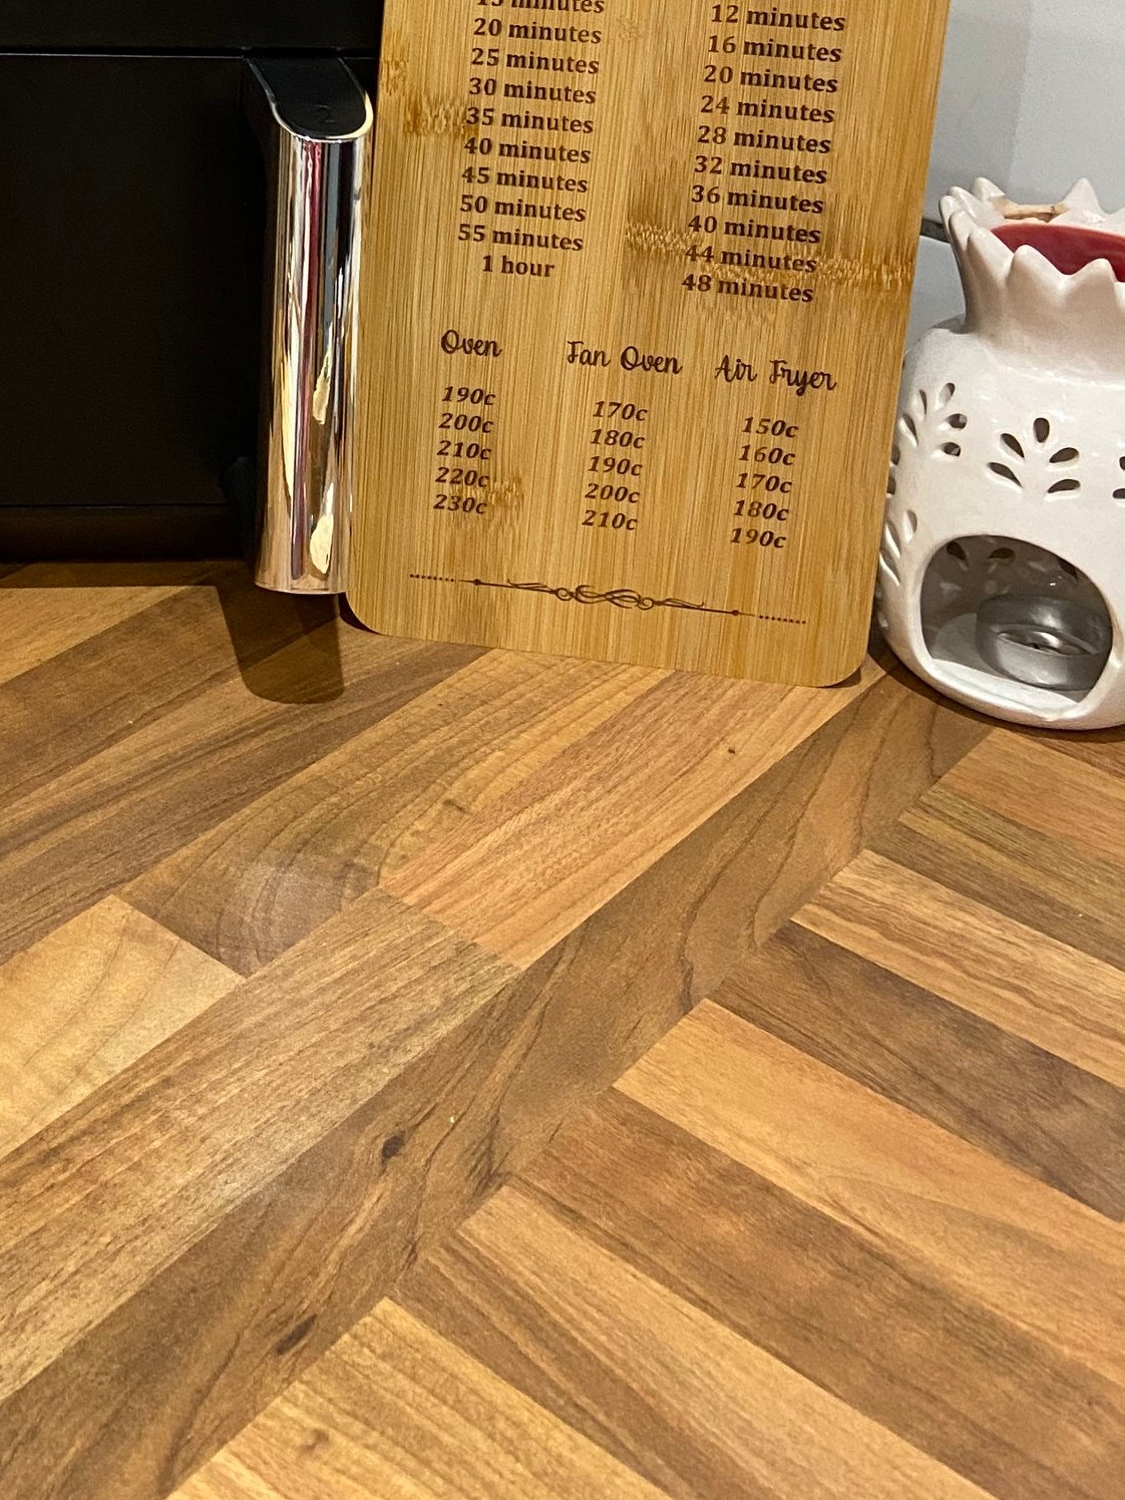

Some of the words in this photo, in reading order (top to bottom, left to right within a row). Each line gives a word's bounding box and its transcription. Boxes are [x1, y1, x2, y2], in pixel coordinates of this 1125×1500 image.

[473, 18, 502, 38] 20
[508, 21, 602, 44] minutes
[710, 4, 739, 24] 12
[745, 7, 846, 32] minutes
[471, 48, 499, 67] 25
[506, 51, 600, 74] minutes
[708, 35, 737, 54] 16
[743, 38, 842, 63] minutes
[469, 78, 497, 97] 30
[503, 81, 597, 104] minutes
[703, 65, 733, 84] 20
[739, 69, 839, 94] minutes
[700, 95, 729, 115] 24
[737, 100, 835, 124] minutes
[464, 137, 492, 156] 40
[498, 140, 591, 164] minutes
[697, 125, 726, 145] 28
[733, 130, 832, 154] minutes
[462, 166, 490, 186] 45
[496, 170, 589, 193] minutes
[695, 155, 723, 175] 32
[730, 160, 828, 185] minutes
[460, 195, 487, 214] 50
[494, 198, 587, 222] minutes
[691, 185, 721, 204] 36
[727, 189, 824, 214] minutes
[458, 224, 486, 243] 55
[492, 228, 584, 251] minutes
[688, 215, 717, 234] 40
[724, 219, 821, 244] minutes
[482, 255, 494, 273] 1
[501, 256, 555, 278] hour
[441, 329, 503, 358] Oven
[567, 340, 611, 367] Fan
[620, 346, 683, 374] Oven
[715, 354, 758, 382] Air
[769, 359, 837, 396] Fryer
[442, 385, 496, 406] 190c
[438, 412, 494, 433] 200c
[592, 400, 648, 422] 170c
[590, 429, 645, 450] 180c
[741, 416, 799, 438] 150c
[436, 440, 491, 461] 210c
[739, 444, 796, 466] 160c
[435, 467, 490, 488] 220c
[587, 456, 643, 477] 190c
[585, 483, 640, 504] 200c
[736, 472, 792, 494] 170c
[433, 494, 487, 515] 230c
[733, 500, 789, 522] 180c
[582, 510, 638, 531] 210c
[730, 527, 786, 549] 190c
